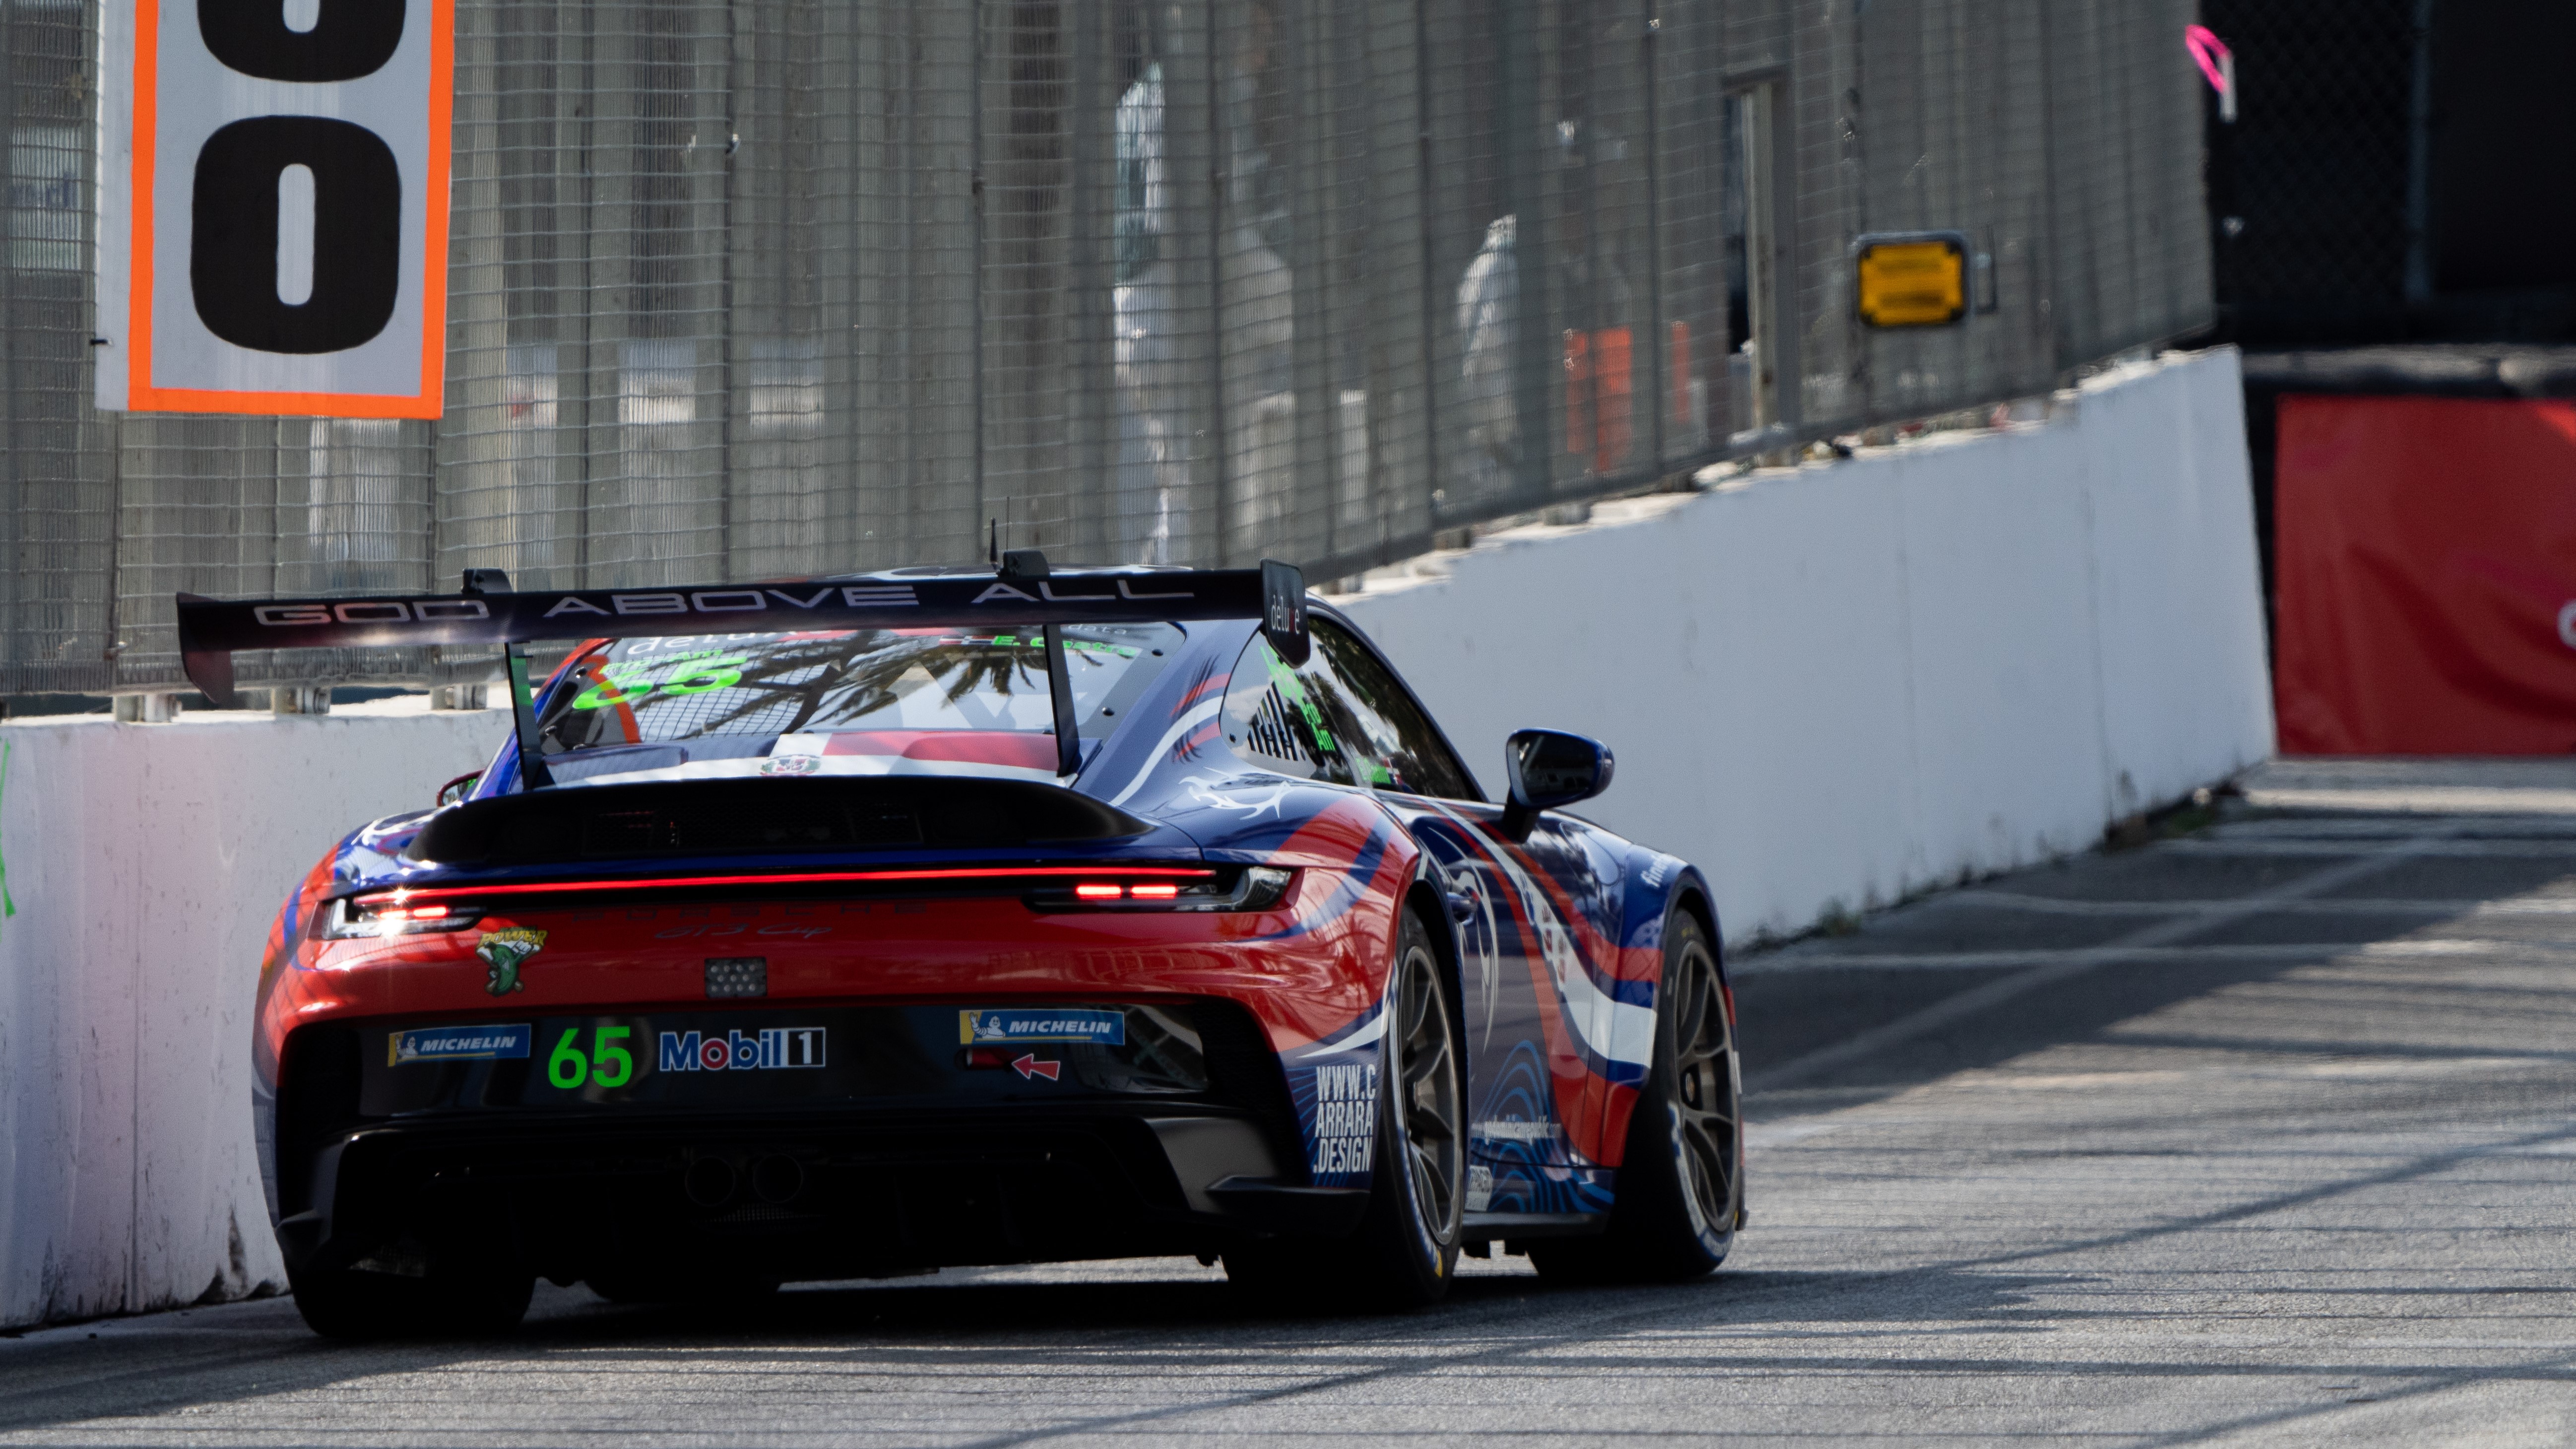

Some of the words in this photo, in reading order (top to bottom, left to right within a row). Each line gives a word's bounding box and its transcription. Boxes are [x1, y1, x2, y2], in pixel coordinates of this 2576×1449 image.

[253, 599, 490, 626] GOD
[543, 585, 919, 618] ABOVE
[970, 579, 1195, 603] ALL
[1271, 594, 1300, 634] deluxe
[1068, 624, 1127, 635] data
[572, 657, 748, 710] 65
[476, 929, 548, 947] POWER
[654, 922, 749, 939] GT3
[757, 922, 834, 939] Cup
[420, 1034, 516, 1052] MICHELIN
[1008, 1020, 1111, 1034] MICHELIN
[547, 1026, 633, 1089] 65
[659, 1028, 787, 1071] Mobil
[795, 1031, 815, 1067] 1
[1316, 1063, 1376, 1101] WWW.C
[1315, 1101, 1374, 1137] ARRARA
[1313, 1137, 1373, 1174] .DESIGN
